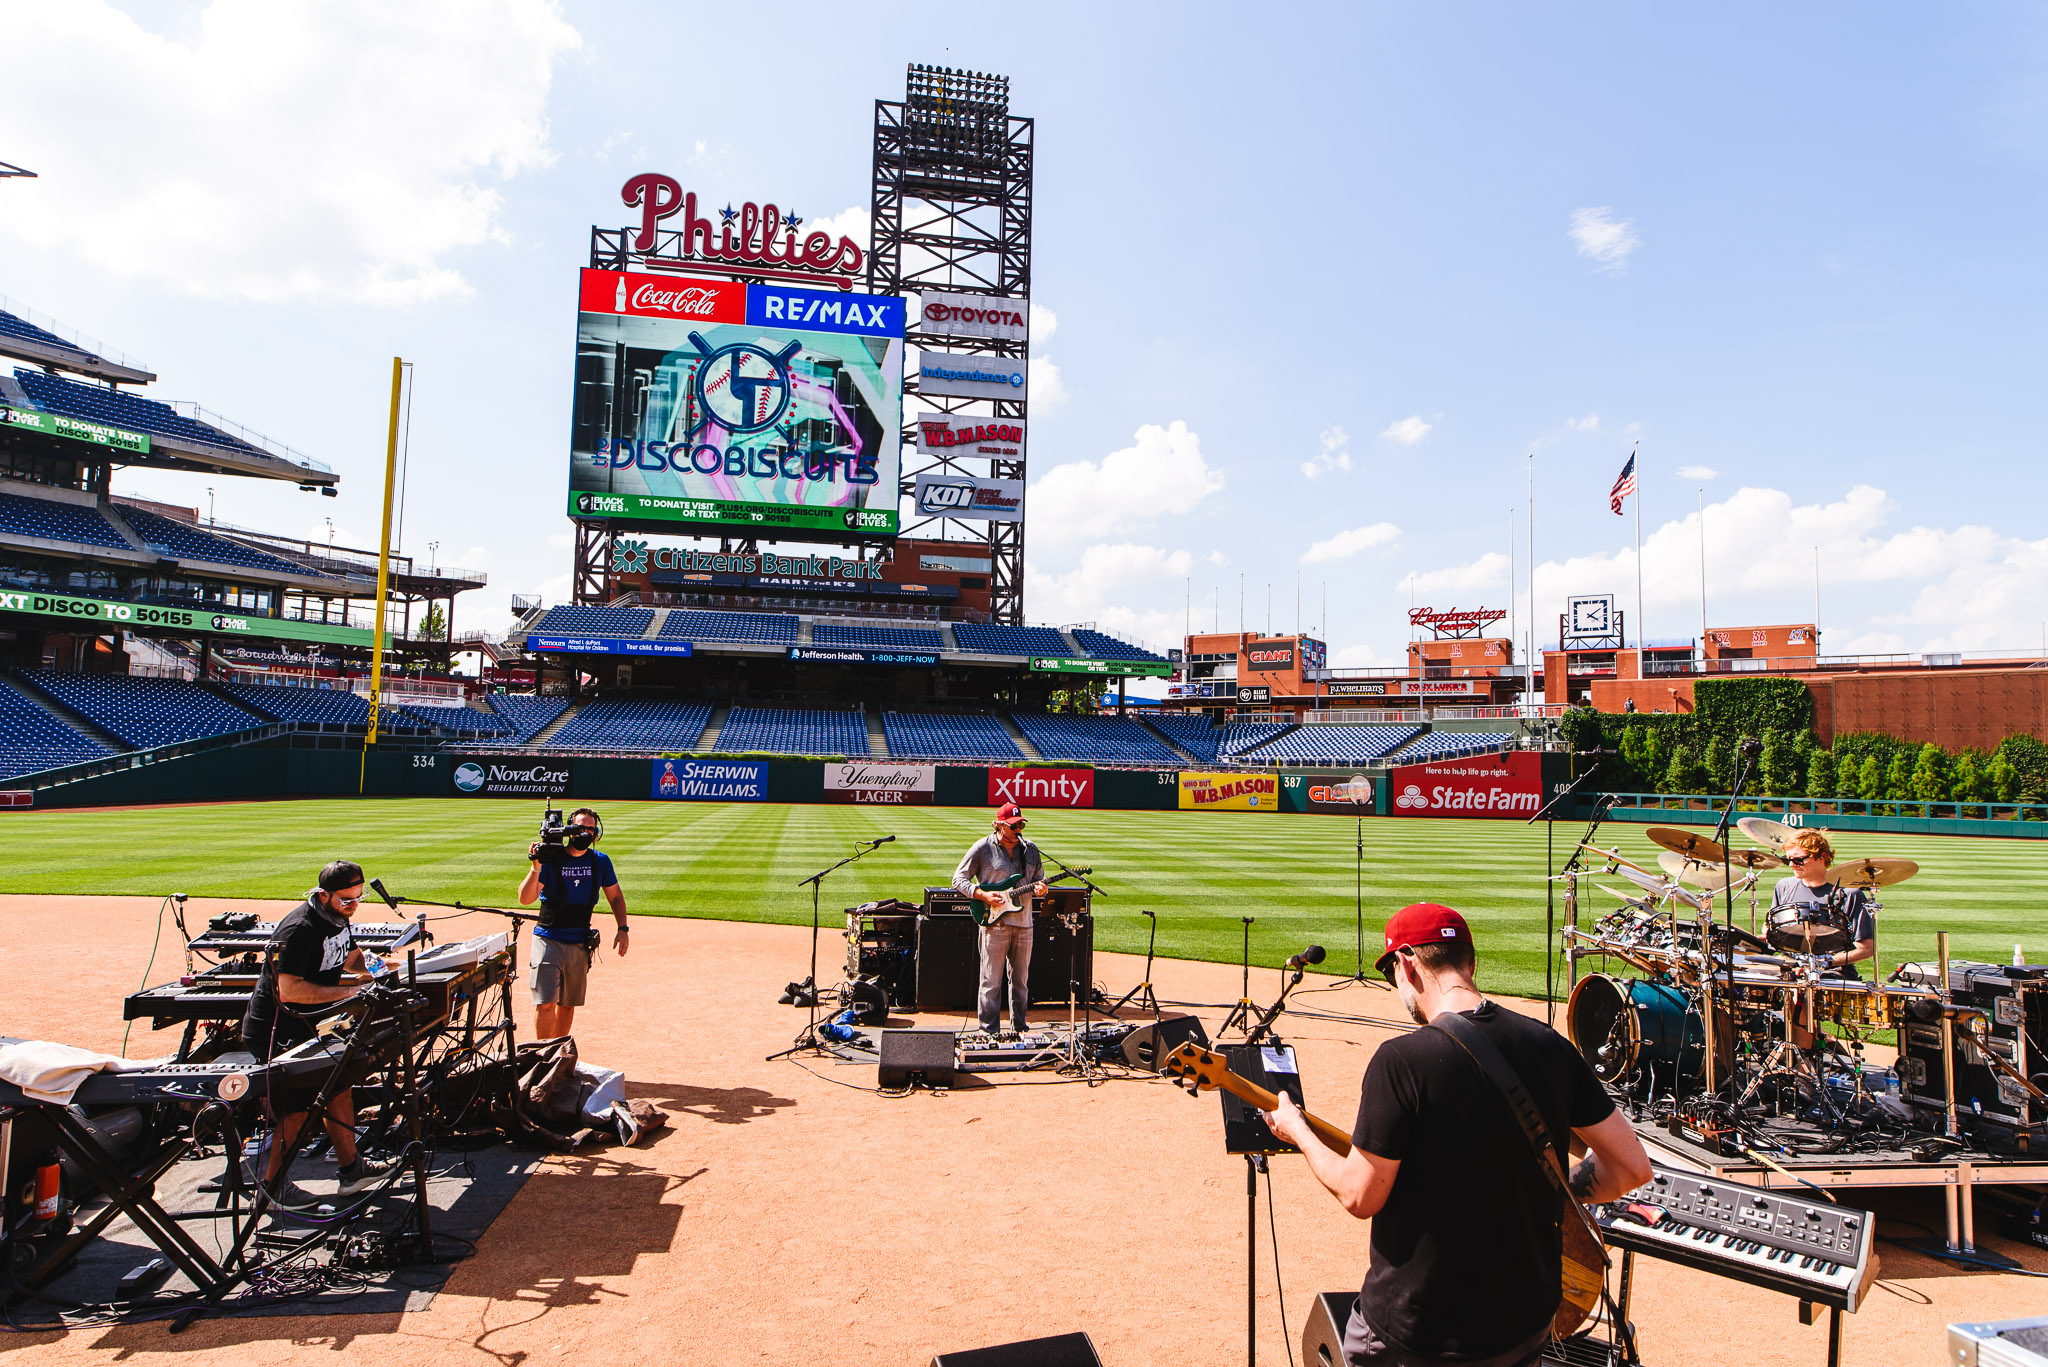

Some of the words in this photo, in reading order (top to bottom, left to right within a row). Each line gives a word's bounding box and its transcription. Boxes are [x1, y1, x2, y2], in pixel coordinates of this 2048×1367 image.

[621, 173, 864, 275] Phillies
[632, 283, 720, 315] Coca-Cola
[765, 295, 887, 328] RE/MAX
[950, 307, 1024, 327] TOYOTA
[922, 366, 1007, 383] Independence
[54, 417, 70, 428] TO
[71, 421, 116, 437] DONATE
[117, 430, 143, 443] TEXT
[925, 424, 1023, 447] W.B.MASON
[56, 427, 90, 439] DISCO
[92, 433, 107, 443] TO
[109, 438, 140, 449] 50155
[592, 437, 609, 467] the
[978, 446, 1001, 454] SINCE
[609, 438, 880, 486] DISCOBISCUITS
[922, 485, 974, 507] KDI
[977, 488, 1001, 497] OFFICE
[594, 496, 624, 505] BLACK
[975, 496, 1021, 507] TECHNOLOGY
[593, 503, 624, 512] LIVES
[639, 498, 651, 507] TO
[653, 499, 690, 509] DONATE
[692, 502, 715, 511] VISIT
[716, 503, 834, 518] PLUS1.ORG/DISCOBISCUITS
[682, 509, 696, 517] OR
[698, 510, 720, 519] TEXT
[722, 511, 749, 520] DISCO
[751, 513, 763, 521] TO
[765, 514, 791, 522] 50155
[860, 512, 887, 521] BLACK
[859, 519, 887, 528] LIVES
[653, 547, 756, 574] Citizens
[762, 553, 825, 577] Bank
[828, 557, 883, 580] Park
[759, 577, 810, 586] HARRY
[33, 597, 99, 616] DISCO
[103, 603, 131, 620] TO
[136, 608, 193, 626] 50155
[1408, 606, 1507, 626] Budweiser
[1717, 632, 1730, 643] 32
[1752, 631, 1766, 642] 36
[1789, 629, 1803, 641] 42
[538, 638, 566, 647] Nemours
[639, 643, 653, 651] child.
[664, 645, 687, 653] promise.
[1451, 644, 1461, 653] 14
[1485, 642, 1496, 652] 20
[801, 650, 837, 660] Jefferson
[838, 651, 865, 661] Health.
[871, 654, 936, 663] 1-800-JEFF-NOW
[1250, 650, 1292, 663] GIANT
[368, 690, 377, 733] 329
[413, 755, 436, 768] 334
[487, 765, 569, 782] NovaCare
[683, 762, 758, 780] SHERWIN
[837, 765, 922, 789] Yuengling
[1426, 766, 1442, 775] Here
[1443, 767, 1450, 775] to
[1468, 767, 1479, 776] life
[1480, 769, 1489, 777] go
[1490, 768, 1509, 777] right.
[1158, 773, 1175, 785] 374
[1182, 780, 1198, 788] WHO
[1199, 779, 1212, 787] BUT
[1284, 776, 1301, 788] 387
[486, 784, 565, 793] REHABILITATON
[681, 780, 758, 797] WILLIAMS
[995, 771, 1088, 805] xfinity
[1192, 778, 1276, 804] W.B.MASON
[855, 790, 903, 803] LAGER
[1431, 786, 1487, 809] State
[1488, 787, 1540, 811] Farm
[1781, 813, 1804, 827] 401
